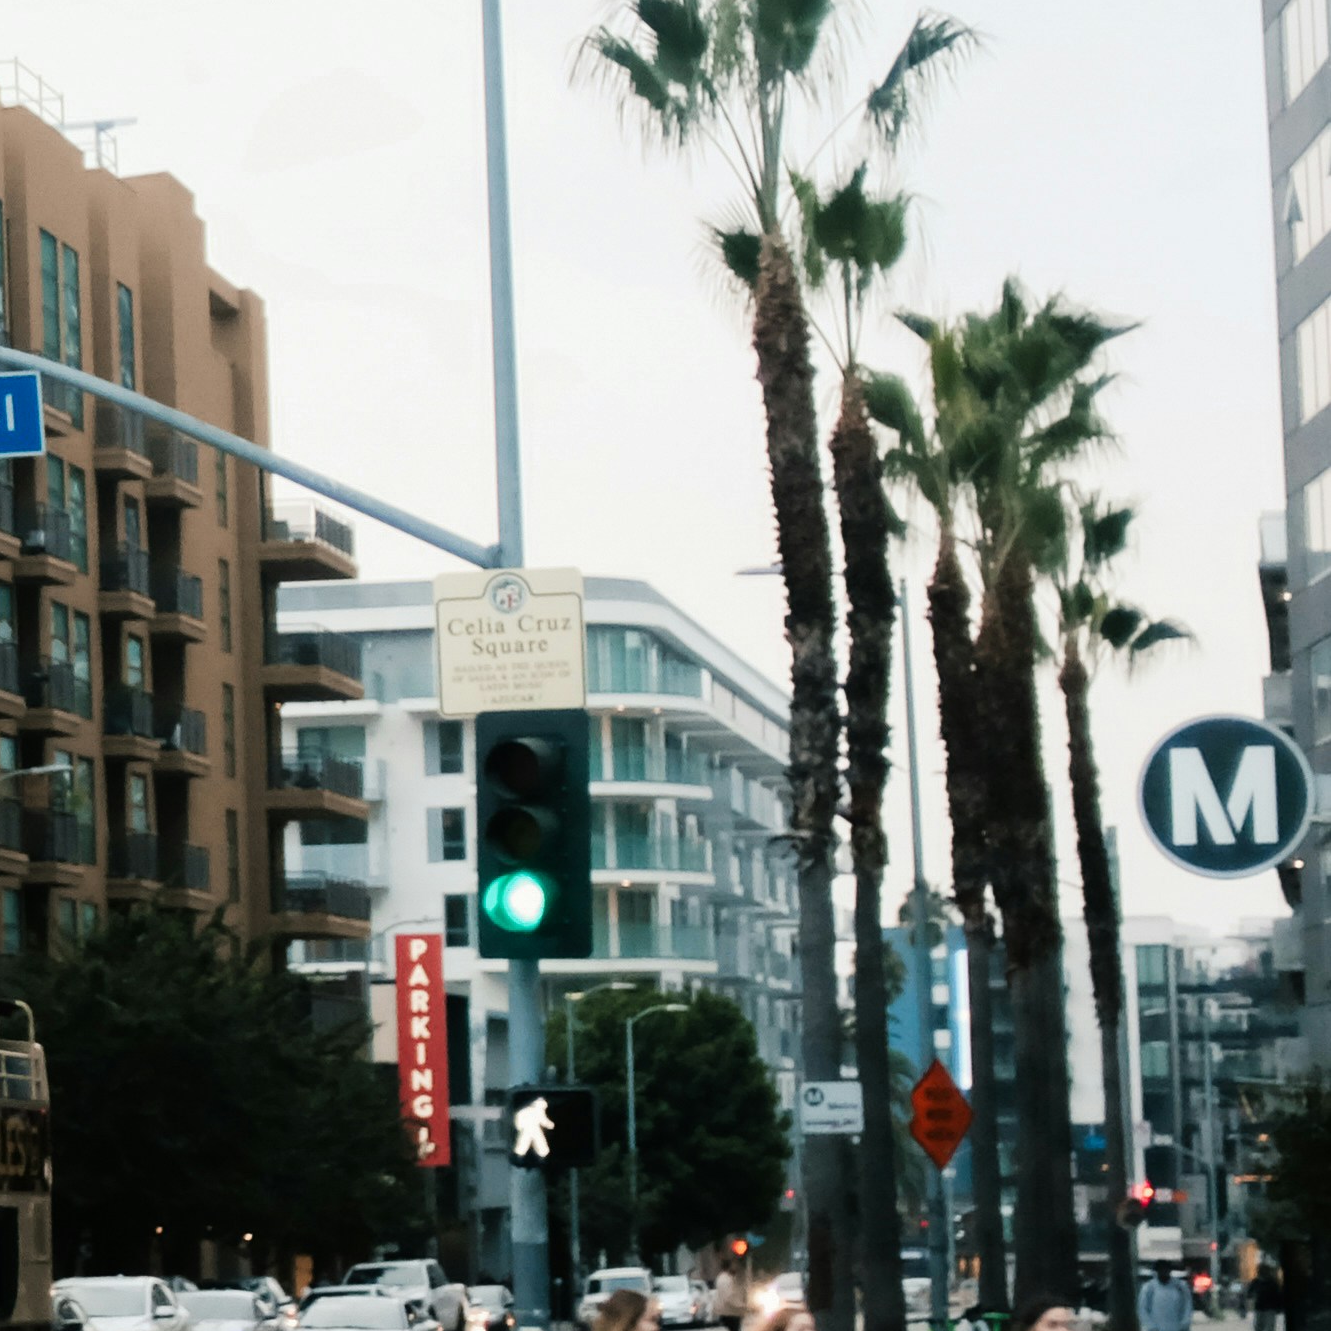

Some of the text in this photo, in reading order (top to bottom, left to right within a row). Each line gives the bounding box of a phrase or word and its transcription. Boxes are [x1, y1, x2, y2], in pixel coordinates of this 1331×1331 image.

[448, 613, 573, 637] Celia Cruz
[471, 638, 549, 658] Square
[1169, 744, 1280, 846] M
[407, 938, 435, 1119] PARKING
